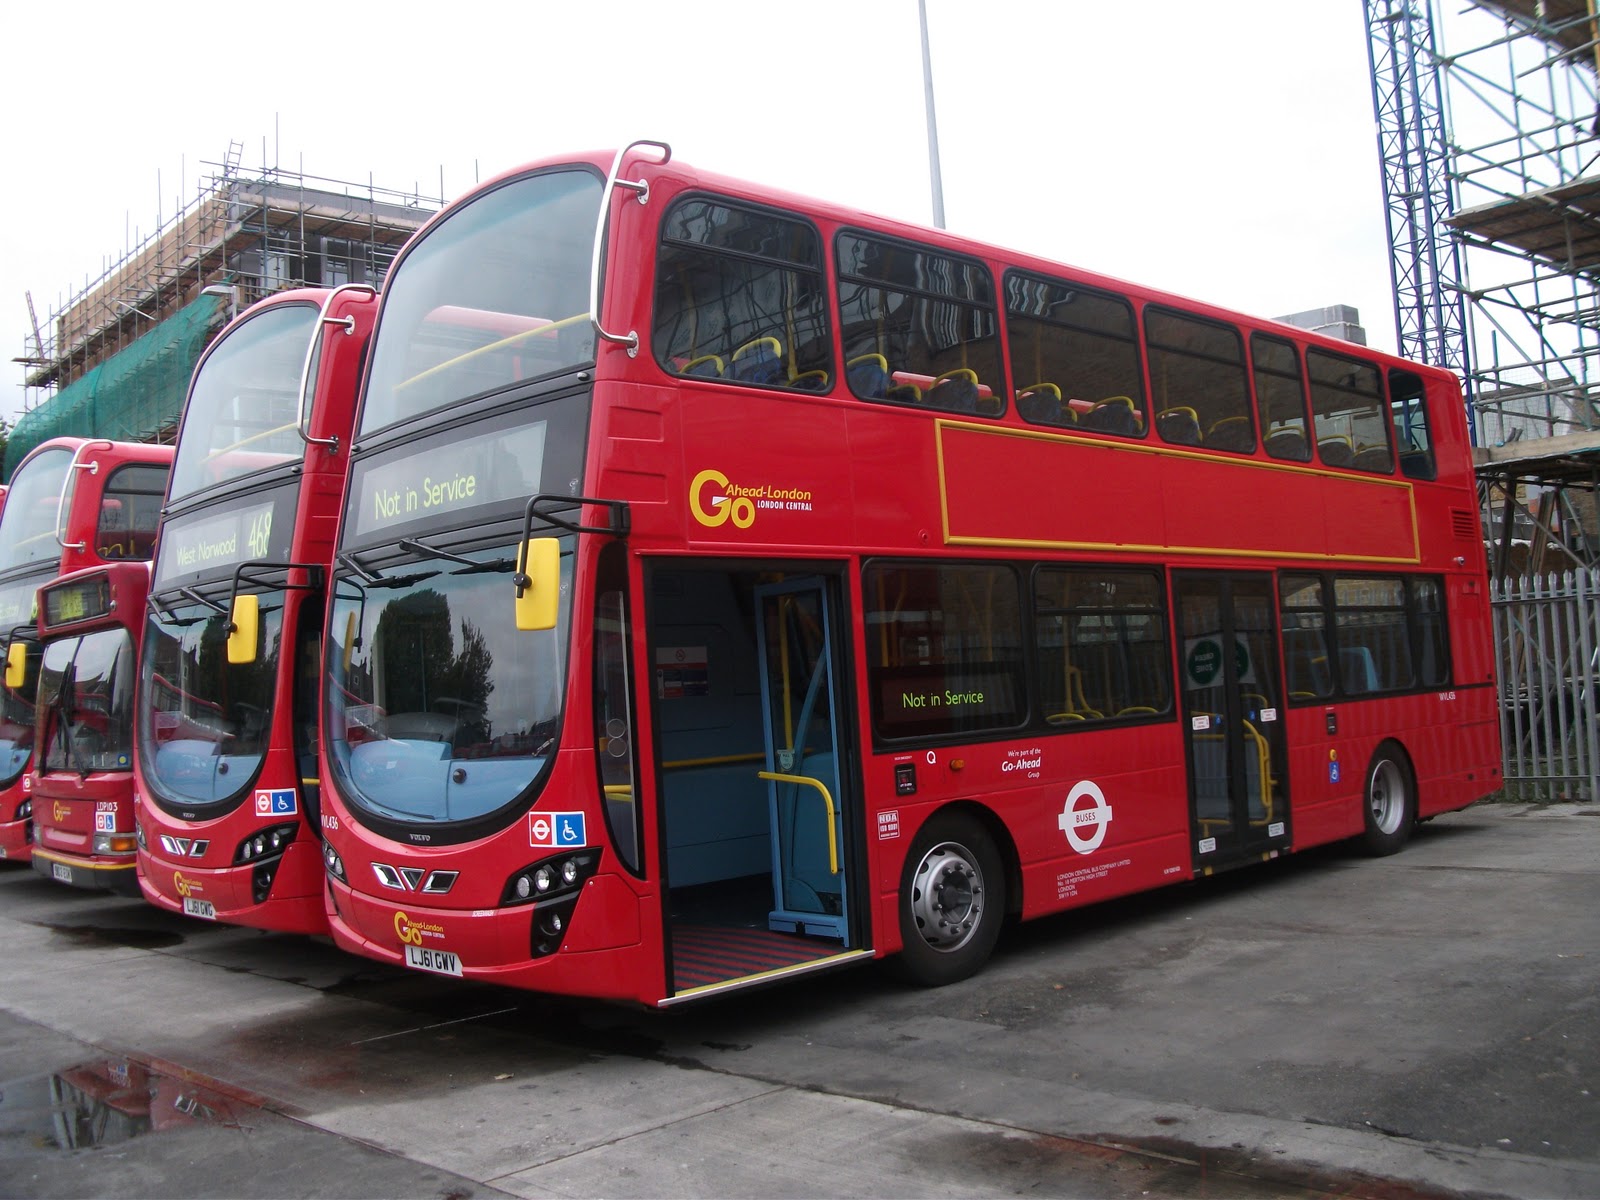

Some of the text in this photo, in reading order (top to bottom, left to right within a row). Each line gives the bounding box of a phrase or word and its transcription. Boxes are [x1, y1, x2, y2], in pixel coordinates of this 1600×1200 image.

[375, 473, 476, 520] Not in Service
[689, 469, 811, 528] Go Ahead-London
[757, 499, 812, 511] LONDON CENTRAL
[248, 511, 272, 557] 468
[176, 532, 236, 566] West Norwood
[902, 690, 984, 708] Not in Service
[926, 750, 936, 764] Q
[1030, 747, 1034, 755] of
[1001, 756, 1041, 772] Go-Ahead
[97, 801, 118, 811] LDP103
[1075, 811, 1096, 823] BUSES
[1057, 872, 1074, 880] LONDON
[1074, 868, 1091, 876] CENTRAL
[174, 871, 191, 897] Go
[1057, 884, 1075, 893] LONDON
[394, 911, 444, 945] Go Ahead-London
[411, 947, 455, 972] LJ61 GWV
